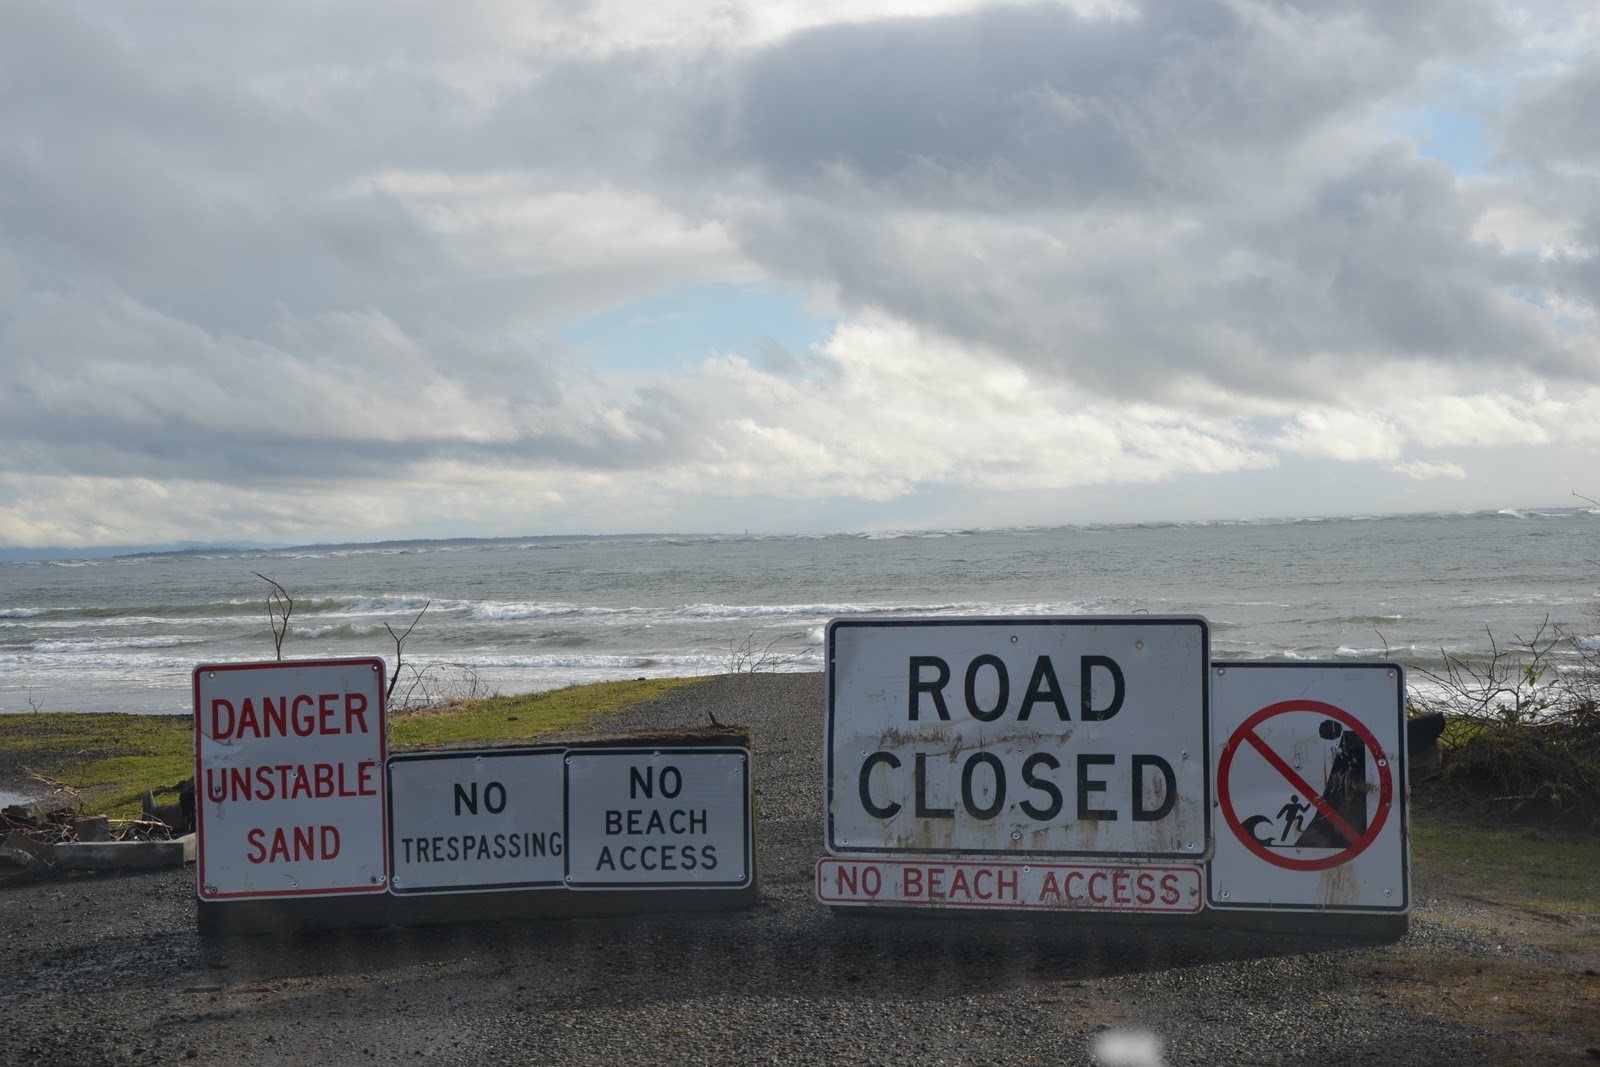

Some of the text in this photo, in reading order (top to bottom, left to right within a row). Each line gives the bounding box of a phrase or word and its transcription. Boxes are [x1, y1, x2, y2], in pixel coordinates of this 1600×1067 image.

[908, 654, 1125, 722] ROAD
[211, 693, 369, 740] DANGER
[207, 761, 377, 803] UNSTABLE
[453, 781, 507, 816] NO
[629, 766, 683, 799] NO
[859, 751, 1177, 821] CLOSED
[605, 809, 708, 835] BEACH
[247, 825, 341, 864] SAND
[401, 832, 563, 863] TRESPASSING
[596, 845, 718, 871] ACCESS
[837, 865, 1181, 905] NO BEACH ACCESS
